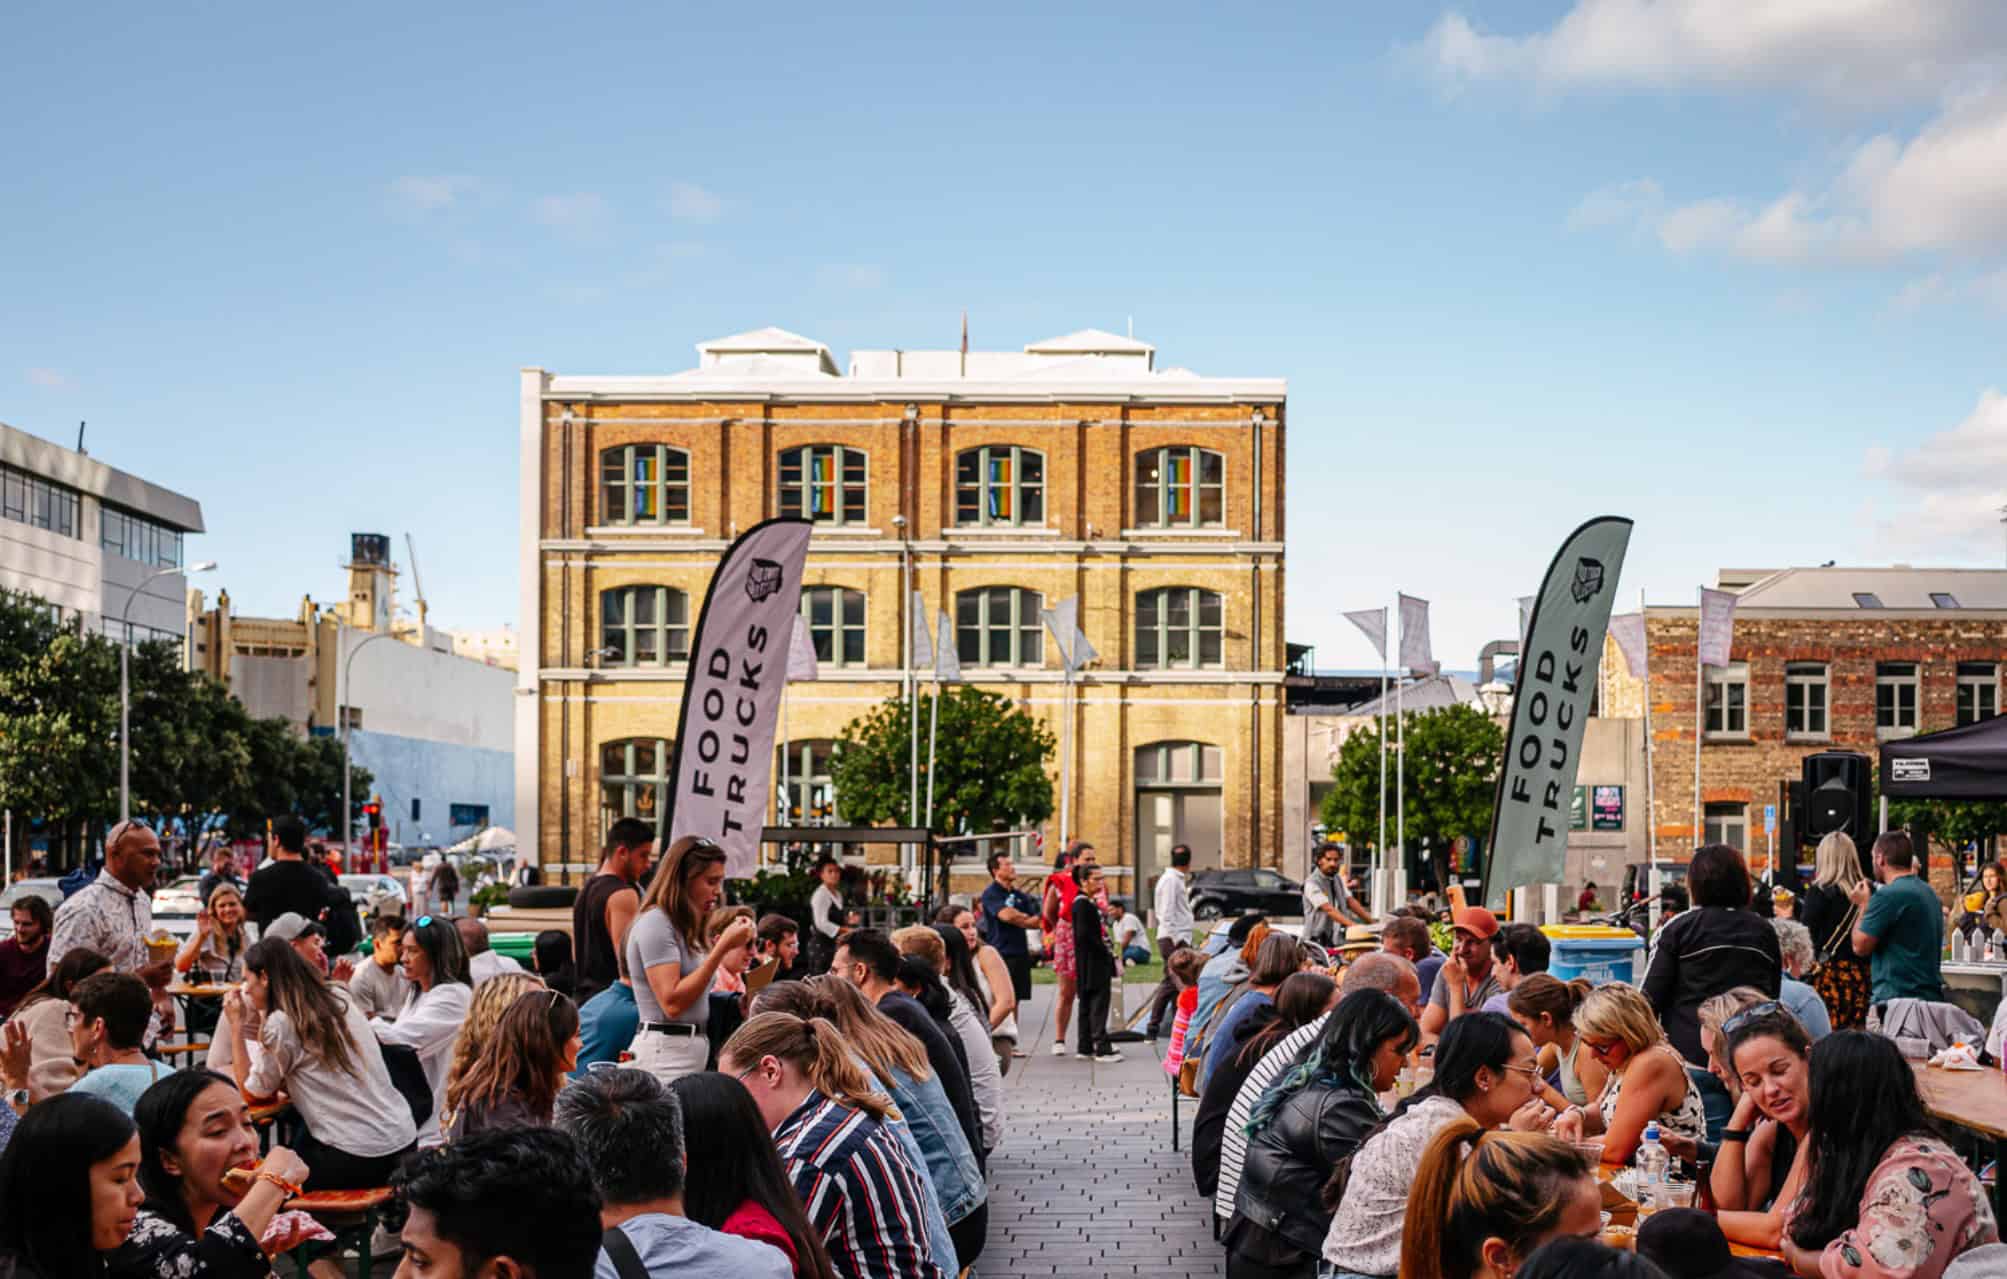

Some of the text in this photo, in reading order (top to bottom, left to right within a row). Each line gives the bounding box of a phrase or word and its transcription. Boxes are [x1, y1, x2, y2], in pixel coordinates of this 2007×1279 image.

[692, 647, 731, 797] FOOD
[722, 624, 768, 837] TRUCKS
[1511, 650, 1555, 803] FOOD
[1535, 625, 1589, 844] TRUCKS
